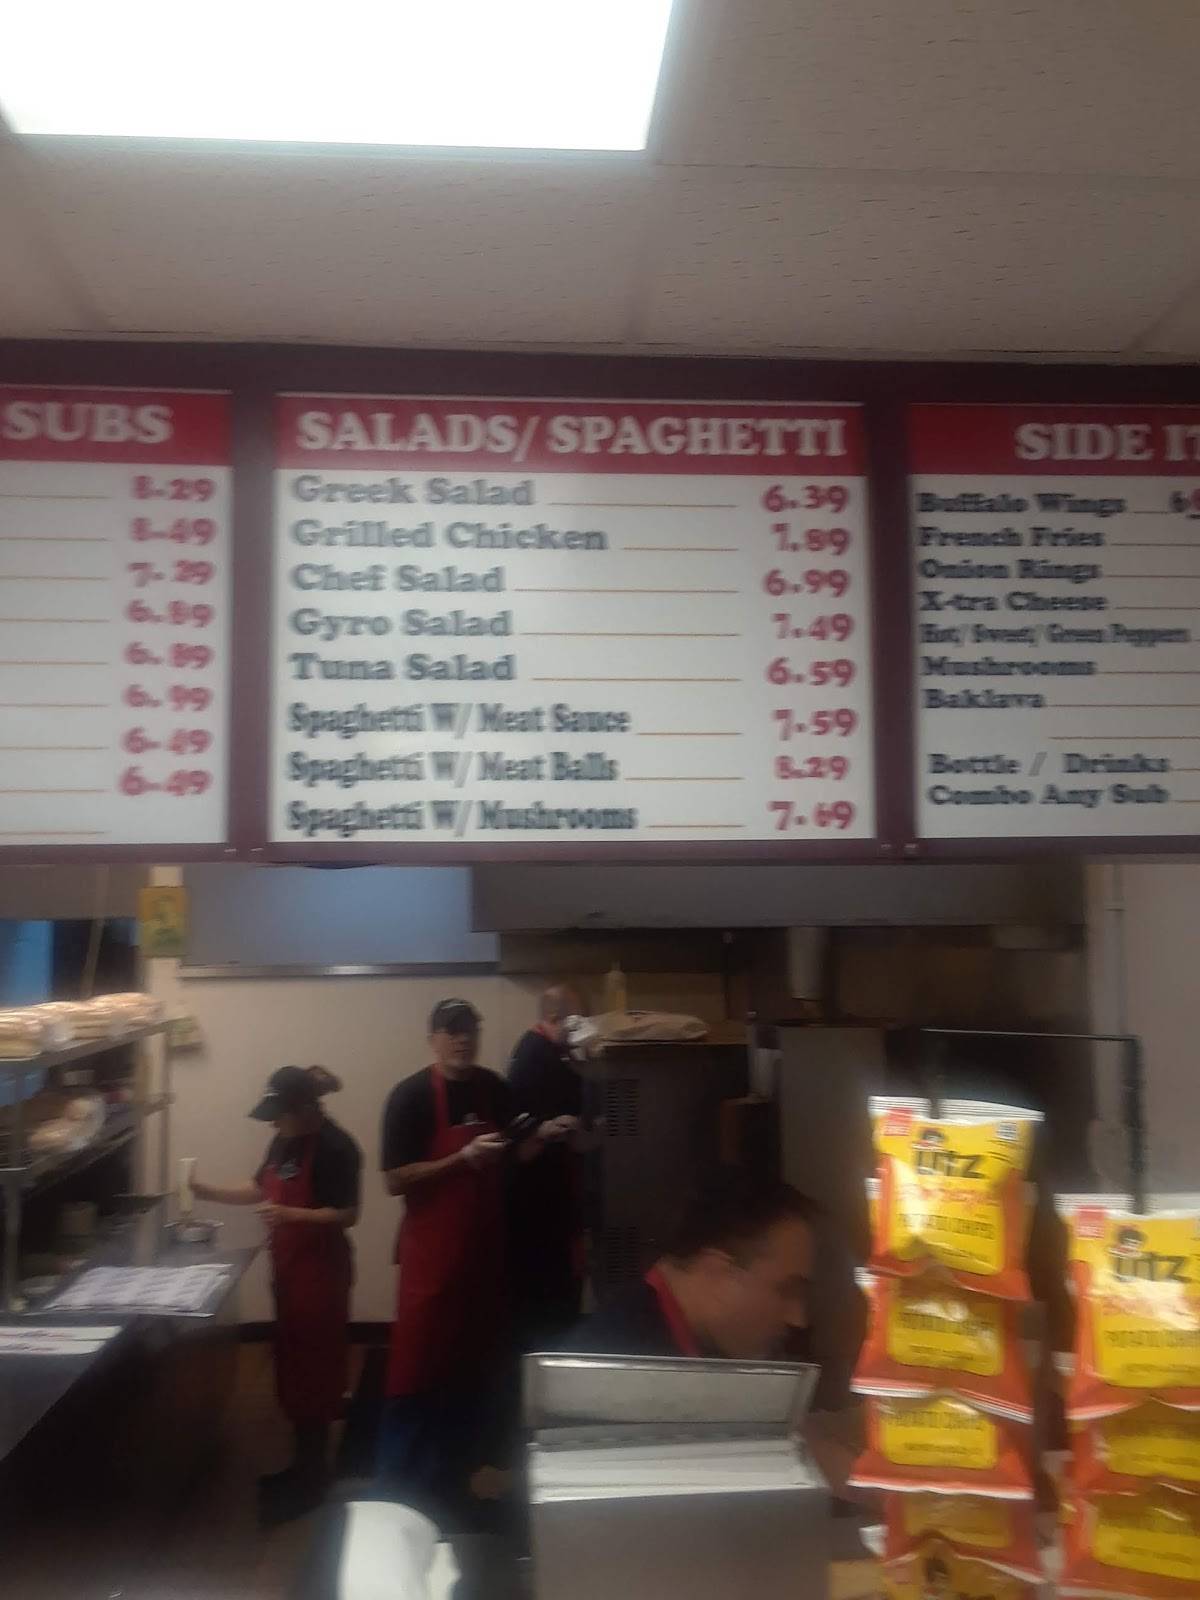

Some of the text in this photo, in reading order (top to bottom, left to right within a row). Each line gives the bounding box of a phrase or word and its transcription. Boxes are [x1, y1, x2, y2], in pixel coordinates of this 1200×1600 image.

[3, 401, 174, 443] SUBS
[549, 415, 847, 457] SPAGHETTI
[1015, 423, 1152, 460] SIDE
[294, 475, 536, 506] Greek Salad
[762, 484, 849, 513] 6.39
[915, 492, 1126, 518] Buffalo Wings
[294, 519, 609, 551] Grilled Chicken
[917, 527, 1106, 547] French Fries
[293, 563, 506, 593] Chef Salad
[764, 568, 850, 599] 6.99
[919, 559, 1102, 584] Onion Rings
[917, 591, 1108, 611] X-tra Cheese
[291, 607, 515, 642] Gyro Salad
[288, 651, 517, 681] Tuna Salad
[766, 656, 857, 688] 6.59
[920, 656, 1097, 676] Mushrooms
[922, 689, 1046, 709] Baklava
[287, 701, 425, 740] Spaghetti
[476, 702, 544, 733] Meat
[552, 702, 633, 733] Sauce
[770, 708, 859, 741] 7.59
[287, 750, 425, 789] Spaghetti
[476, 751, 545, 782] Meat
[550, 751, 618, 782] Balls
[927, 753, 1022, 774] Bottle
[1062, 753, 1170, 773] Drinks
[928, 783, 1170, 808] Combo Any Sub
[287, 800, 425, 838] Spaghetti
[476, 800, 638, 830] Mushrooms
